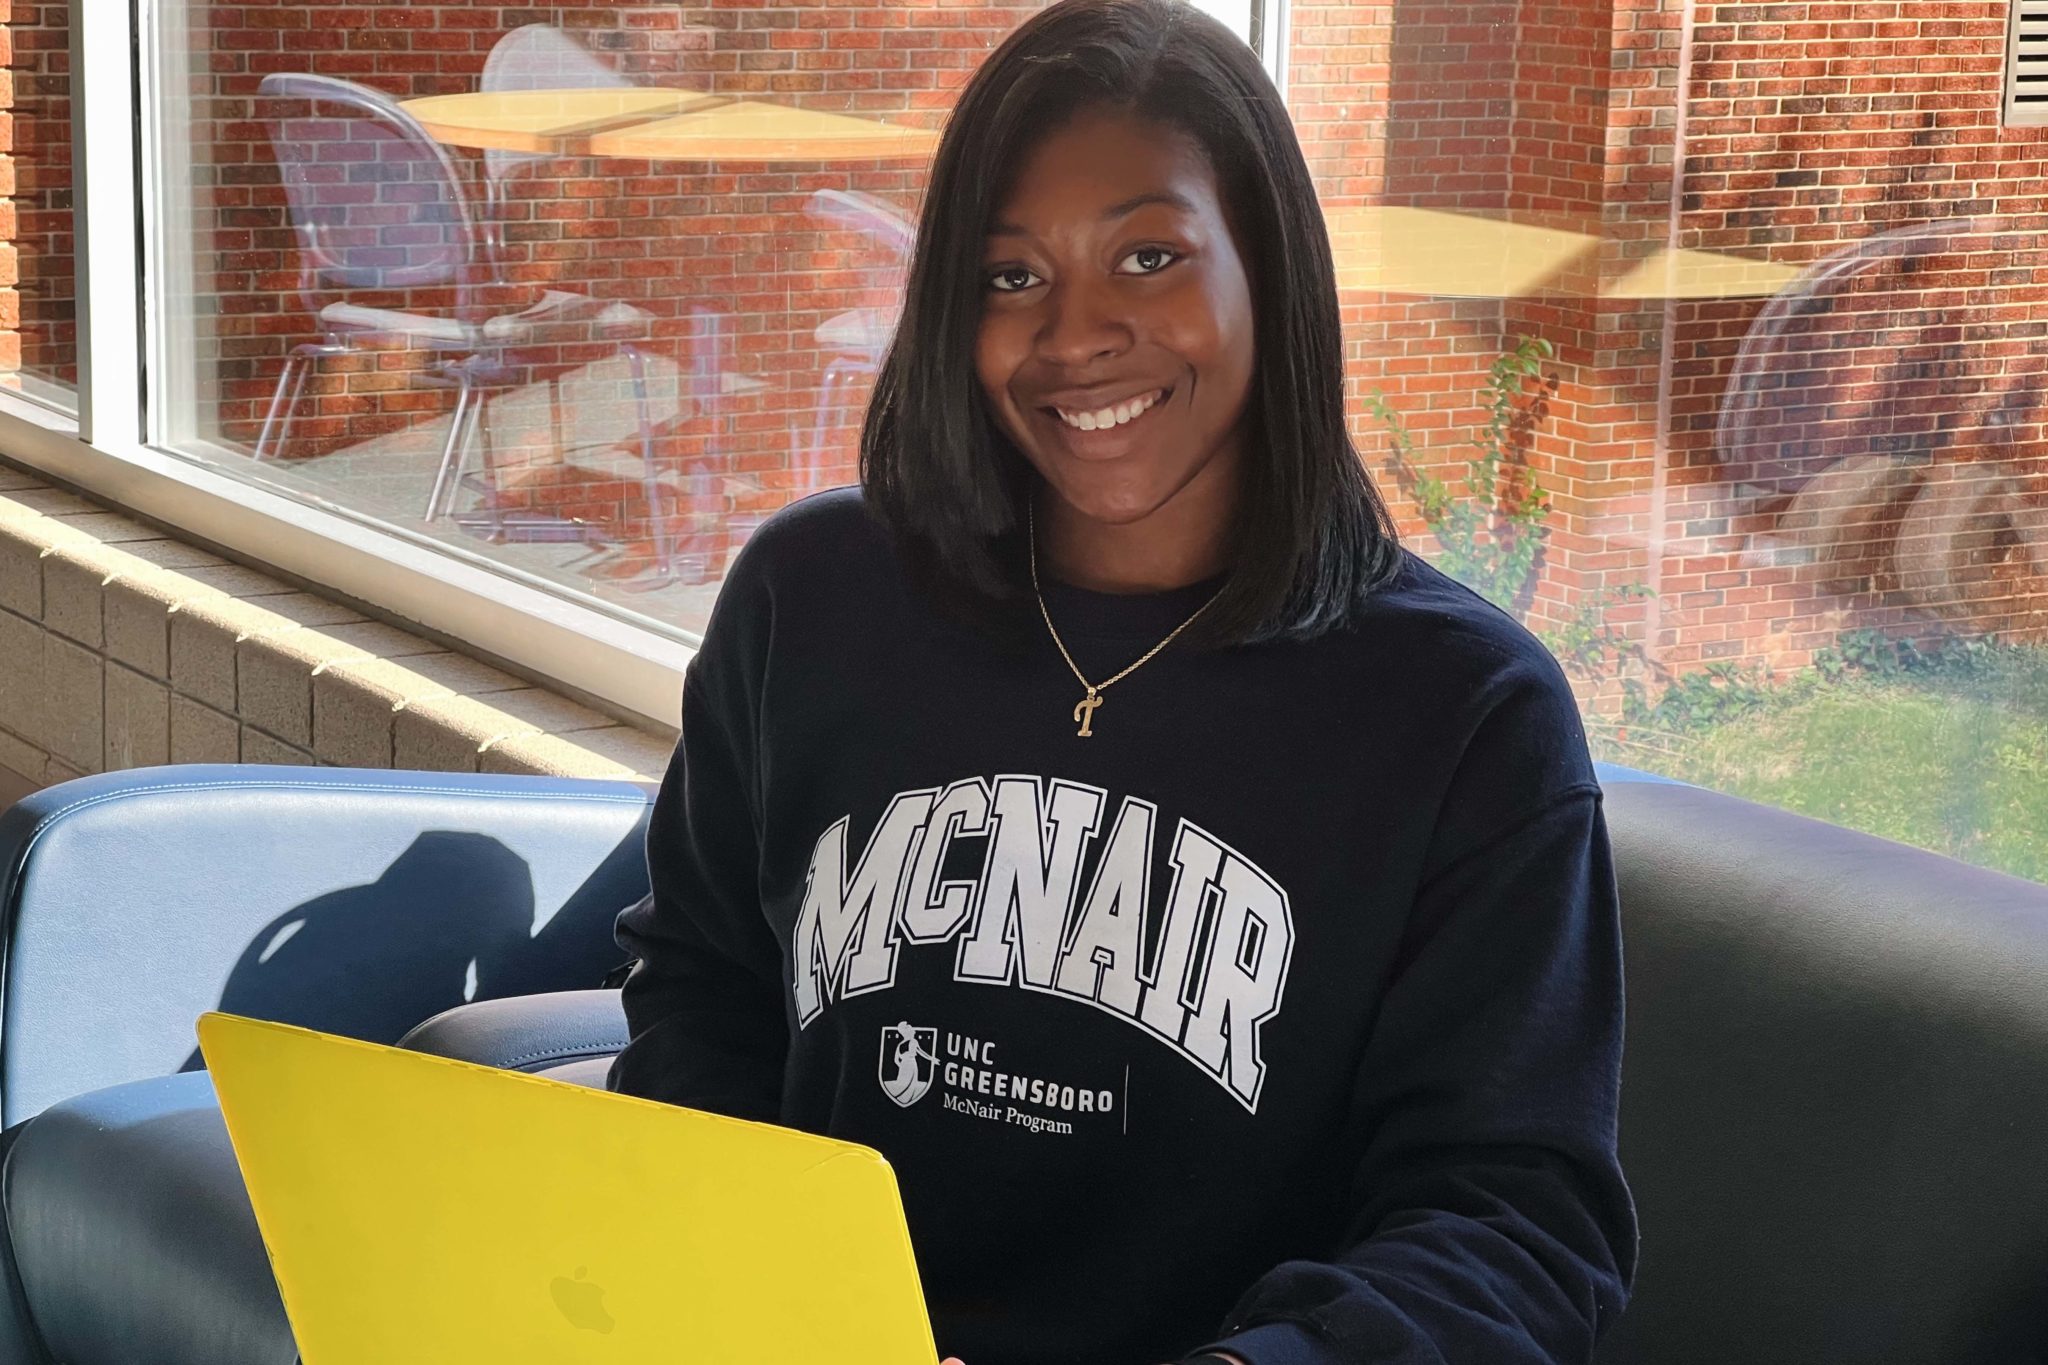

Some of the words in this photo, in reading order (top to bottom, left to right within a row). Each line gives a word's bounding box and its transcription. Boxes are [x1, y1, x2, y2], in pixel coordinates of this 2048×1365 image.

[793, 774, 1296, 1115] MCNAIR
[947, 1032, 996, 1065] UNC
[944, 1062, 1113, 1112] GREENSBORO
[943, 1092, 1002, 1121] McNair
[1005, 1106, 1073, 1134] Program
